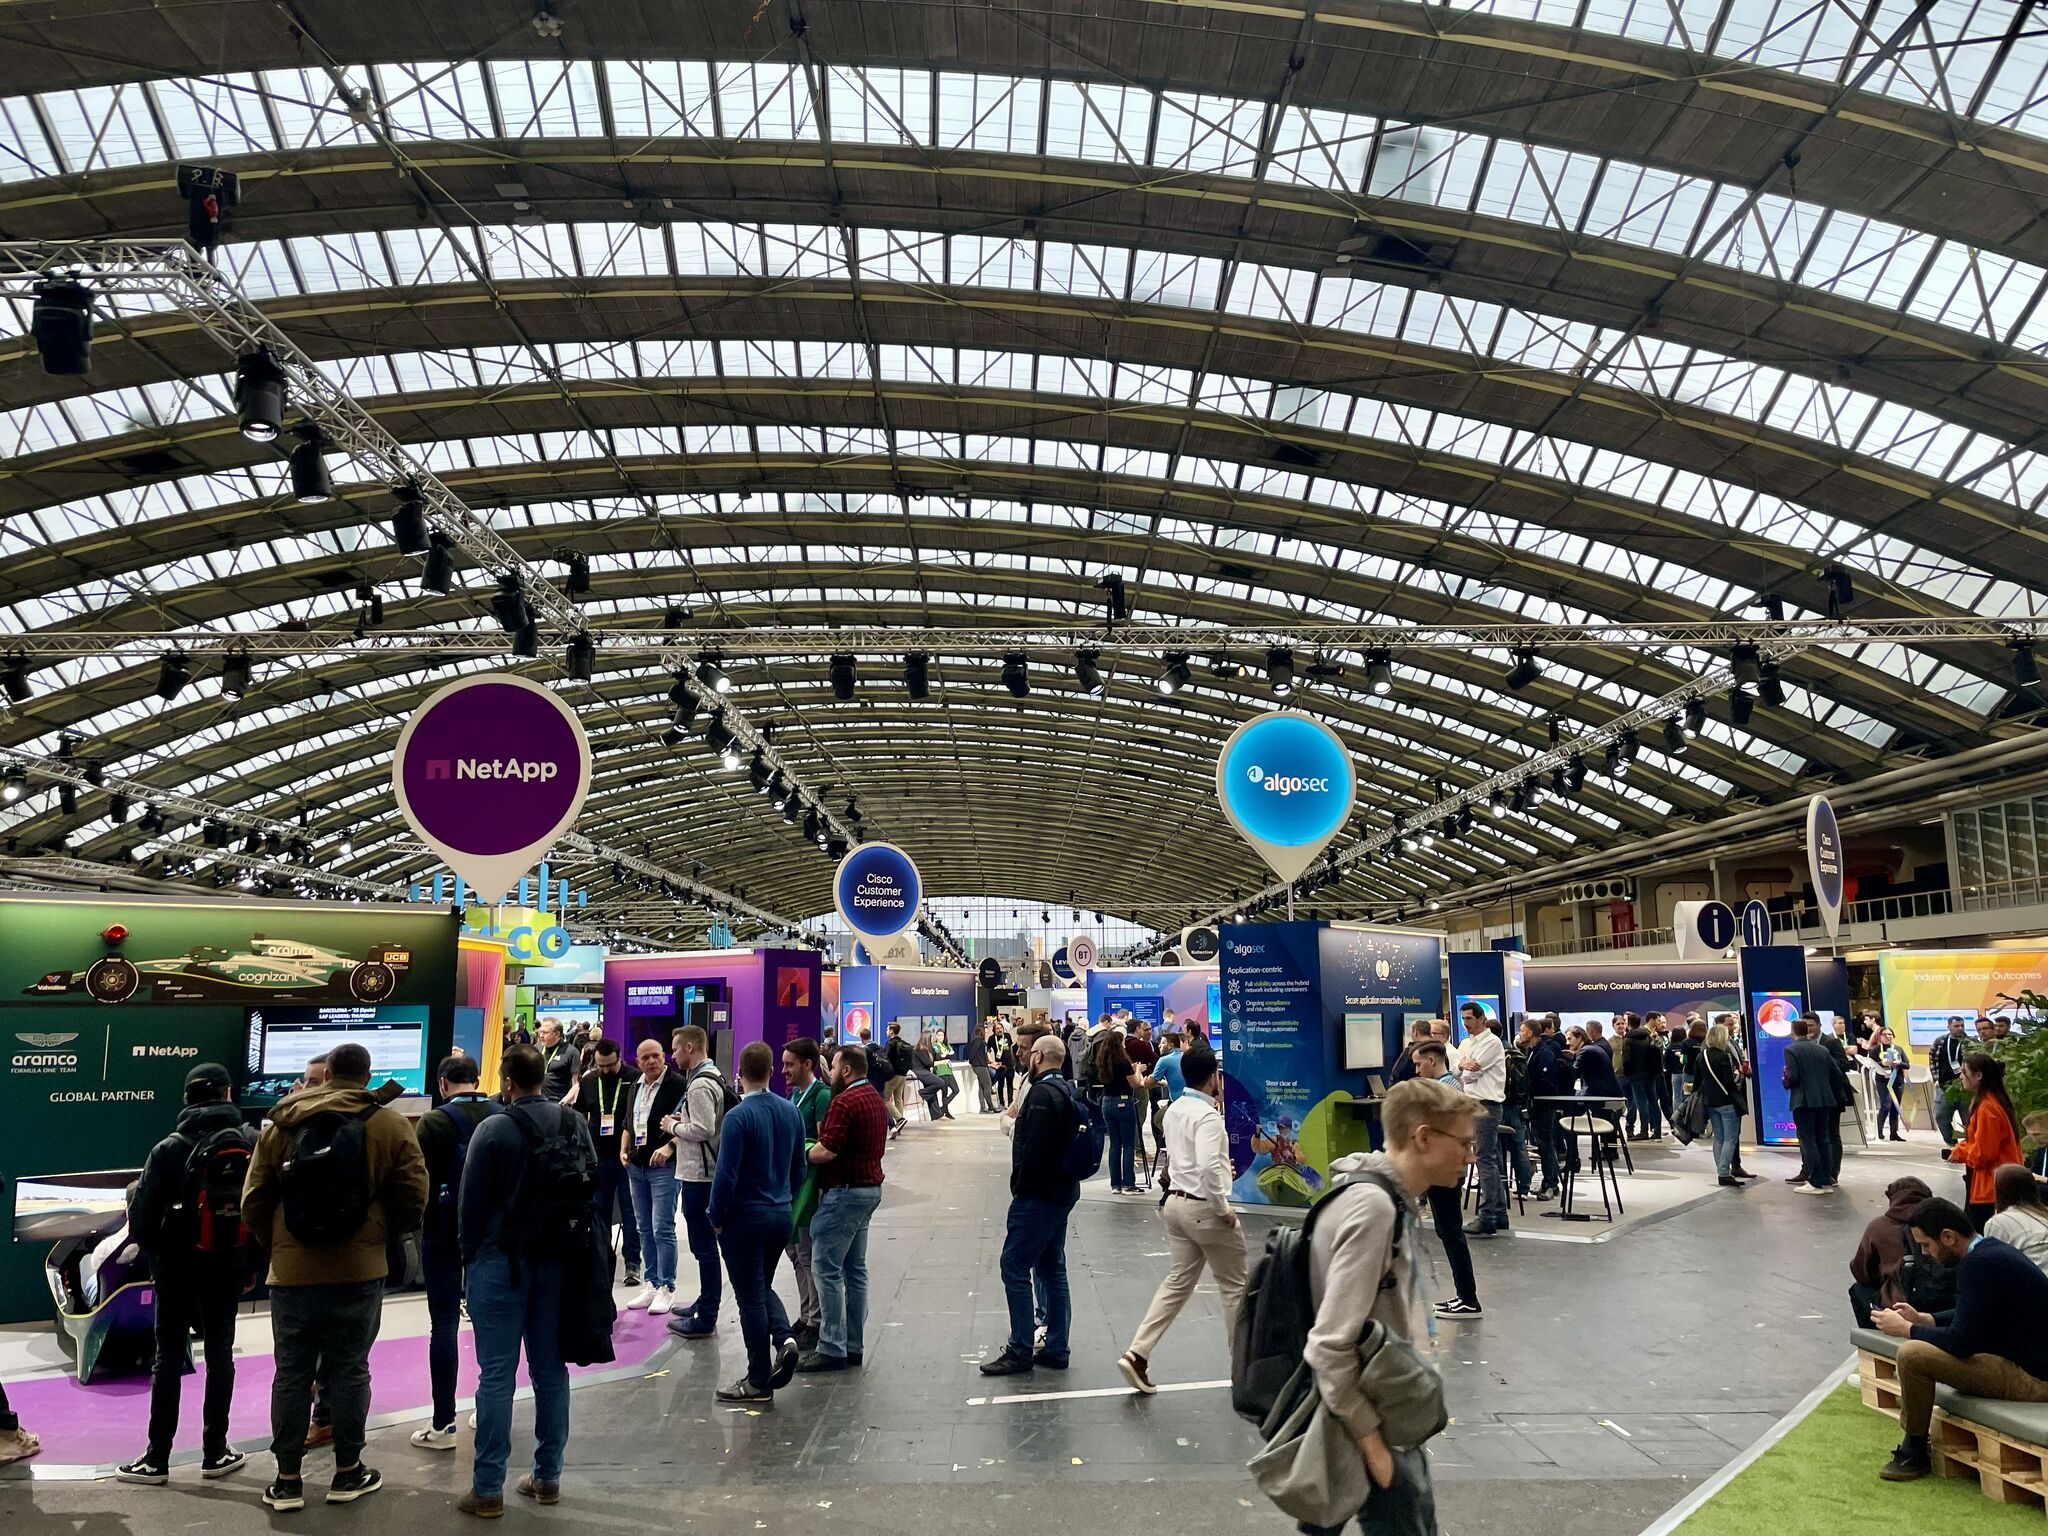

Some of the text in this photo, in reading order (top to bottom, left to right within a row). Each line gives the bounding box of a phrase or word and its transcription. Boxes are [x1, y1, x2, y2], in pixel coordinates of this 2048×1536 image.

[457, 757, 558, 782] NetApp
[1264, 773, 1328, 795] algosec
[867, 874, 892, 884] Cisco
[857, 885, 902, 896] Customer
[854, 896, 904, 908] Experience
[268, 946, 316, 957] aramco
[1078, 951, 1088, 960] BT
[1234, 944, 1266, 956] algosec
[1227, 966, 1283, 975] Application-centric
[239, 972, 298, 984] cognizant
[1914, 974, 1951, 982] Industry
[648, 986, 662, 995] CISCO
[663, 986, 673, 994] LIVE
[1578, 982, 1608, 992] Security
[1610, 982, 1650, 991] Consulting
[1668, 981, 1704, 990] Managed
[149, 1046, 198, 1058] NetApp
[12, 1055, 77, 1065] aramco
[50, 1091, 155, 1102] GLOBAL PARTNER
